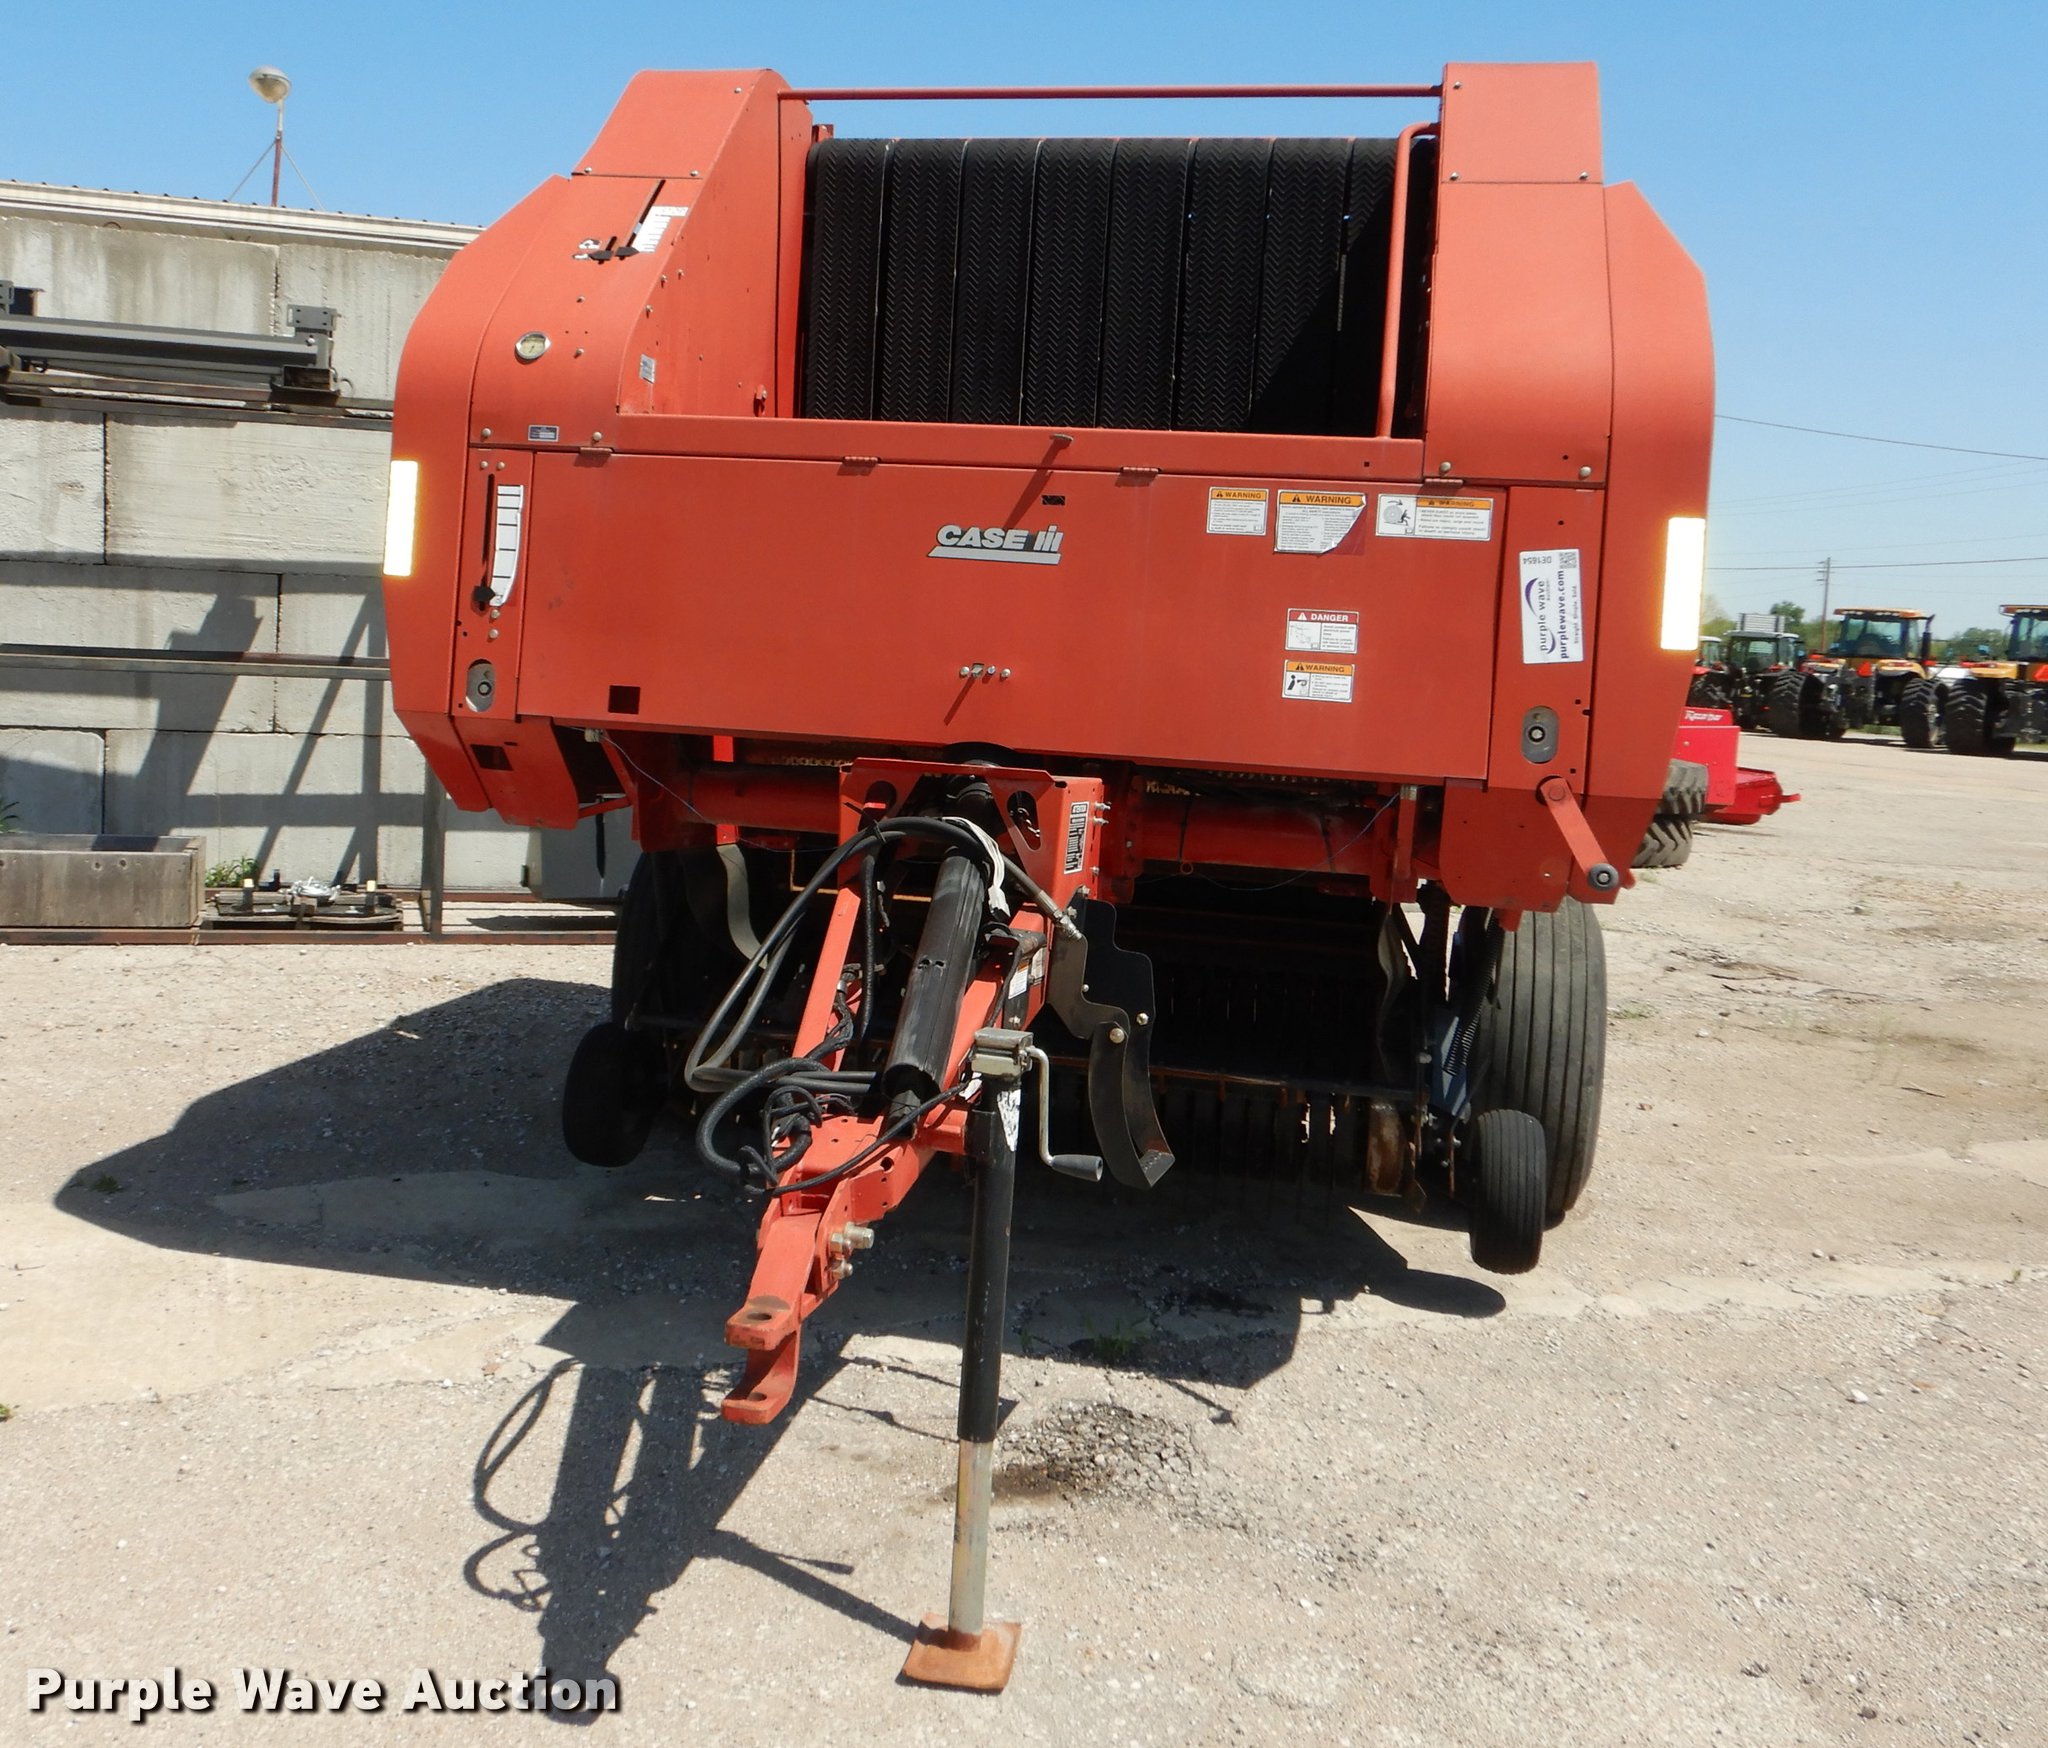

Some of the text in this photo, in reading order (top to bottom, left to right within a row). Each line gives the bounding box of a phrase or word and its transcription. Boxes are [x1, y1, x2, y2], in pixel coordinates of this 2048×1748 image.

[1225, 491, 1262, 499] WARNING
[1305, 495, 1352, 505] WARNING
[936, 525, 1029, 550] CASE
[1310, 613, 1349, 622] DANGER
[1538, 580, 1548, 651] purple wave
[1557, 570, 1570, 659] purplewave.com
[1305, 664, 1345, 673] WARNING
